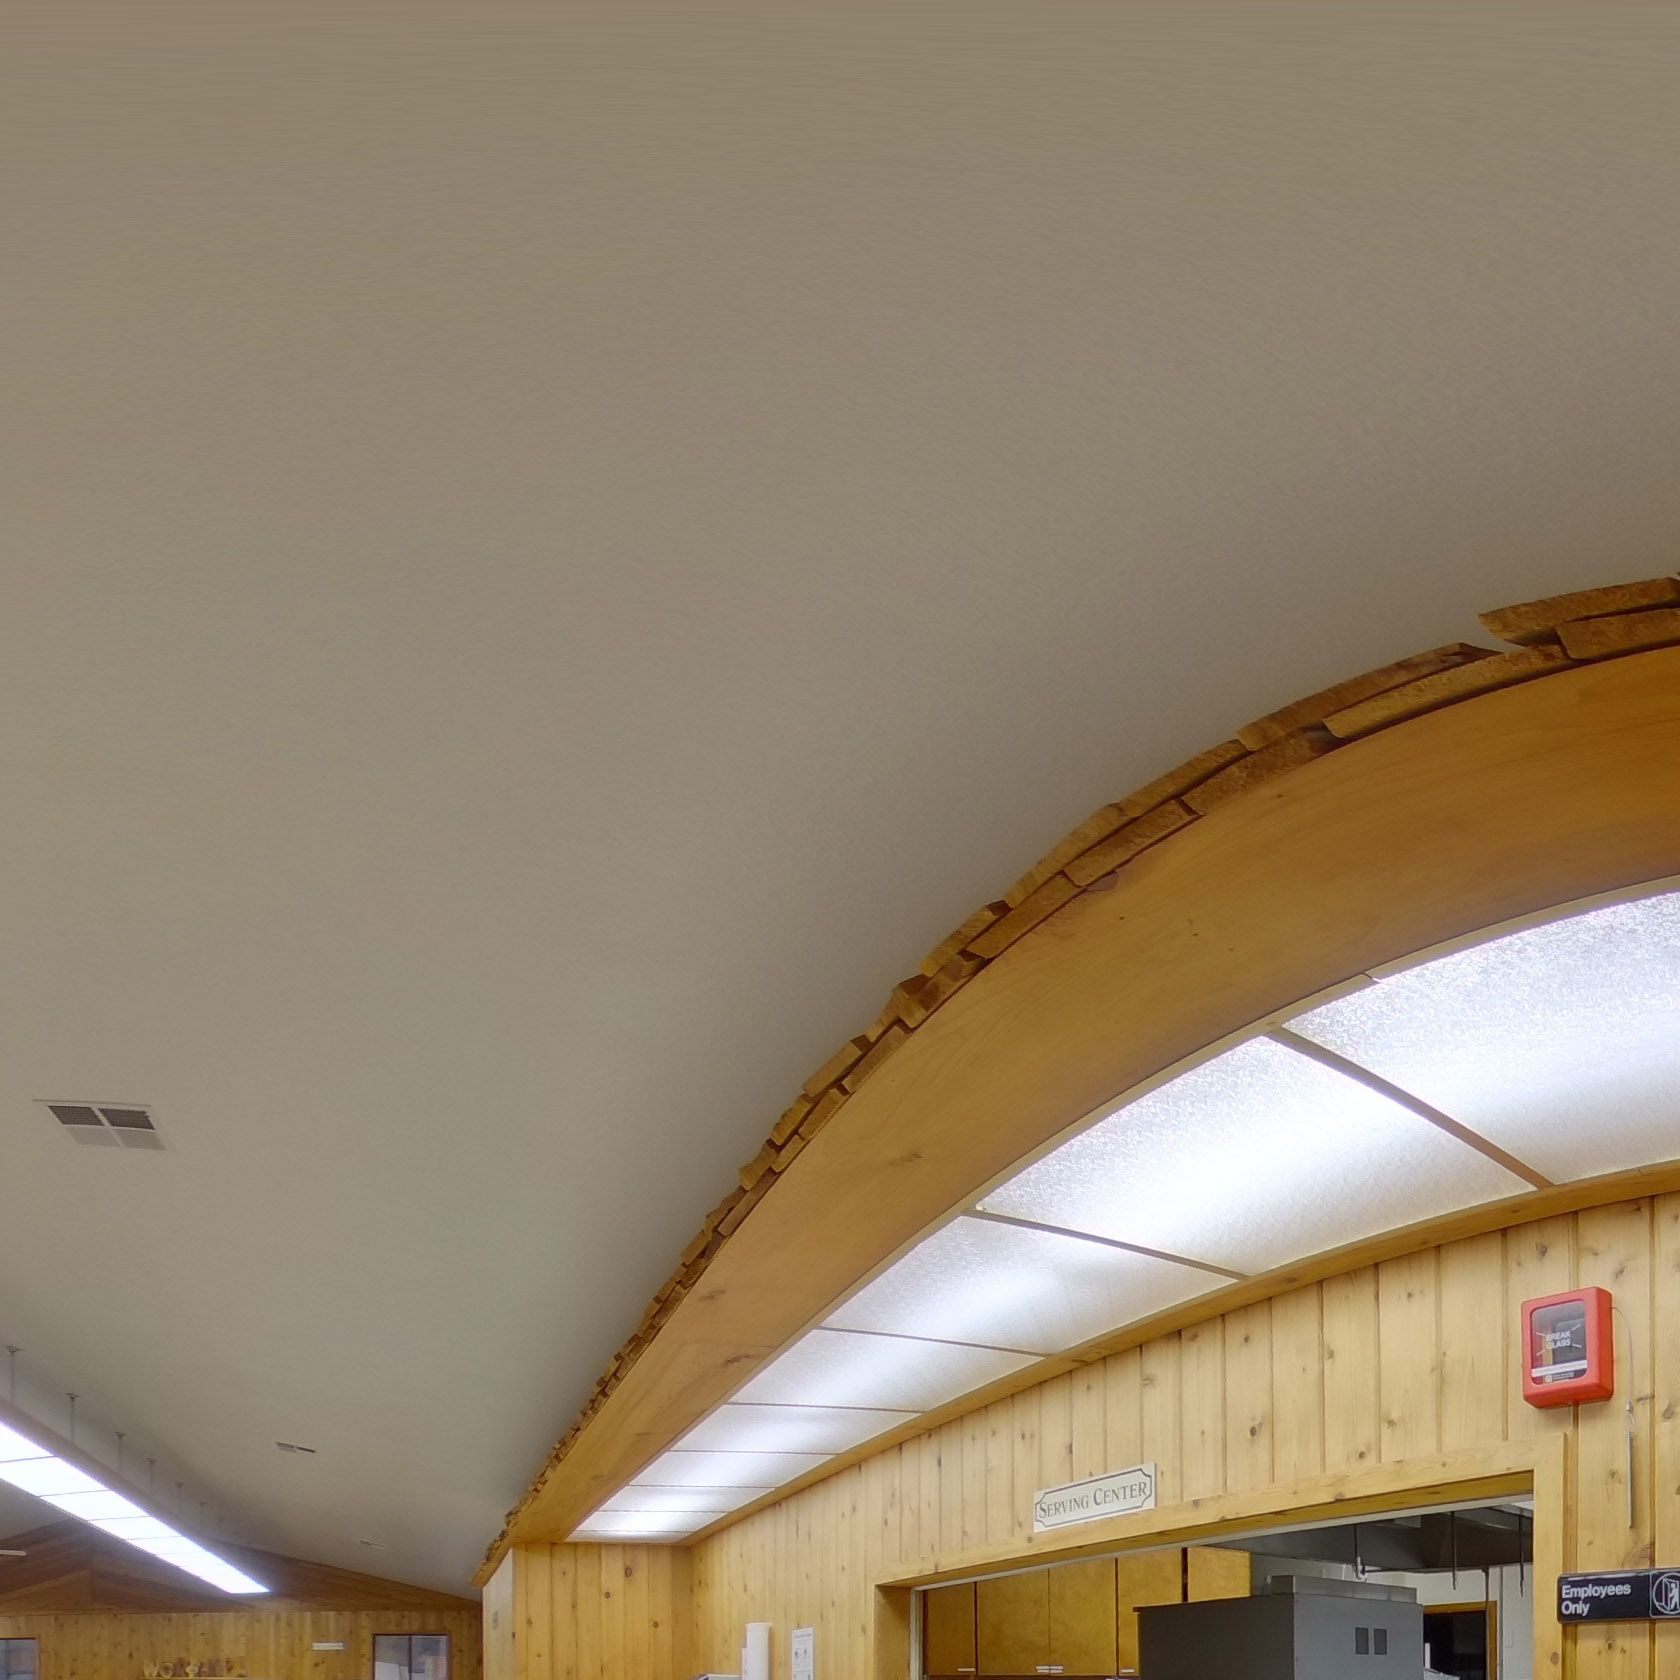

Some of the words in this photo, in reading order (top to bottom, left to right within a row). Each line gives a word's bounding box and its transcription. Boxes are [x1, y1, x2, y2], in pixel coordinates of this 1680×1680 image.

[1546, 1331, 1571, 1341] BREAK
[1546, 1339, 1571, 1349] GLASS
[1039, 1495, 1089, 1518] SERVING
[1093, 1481, 1147, 1506] CENTER
[1561, 1584, 1631, 1599] Employees
[1561, 1601, 1590, 1616] Only
